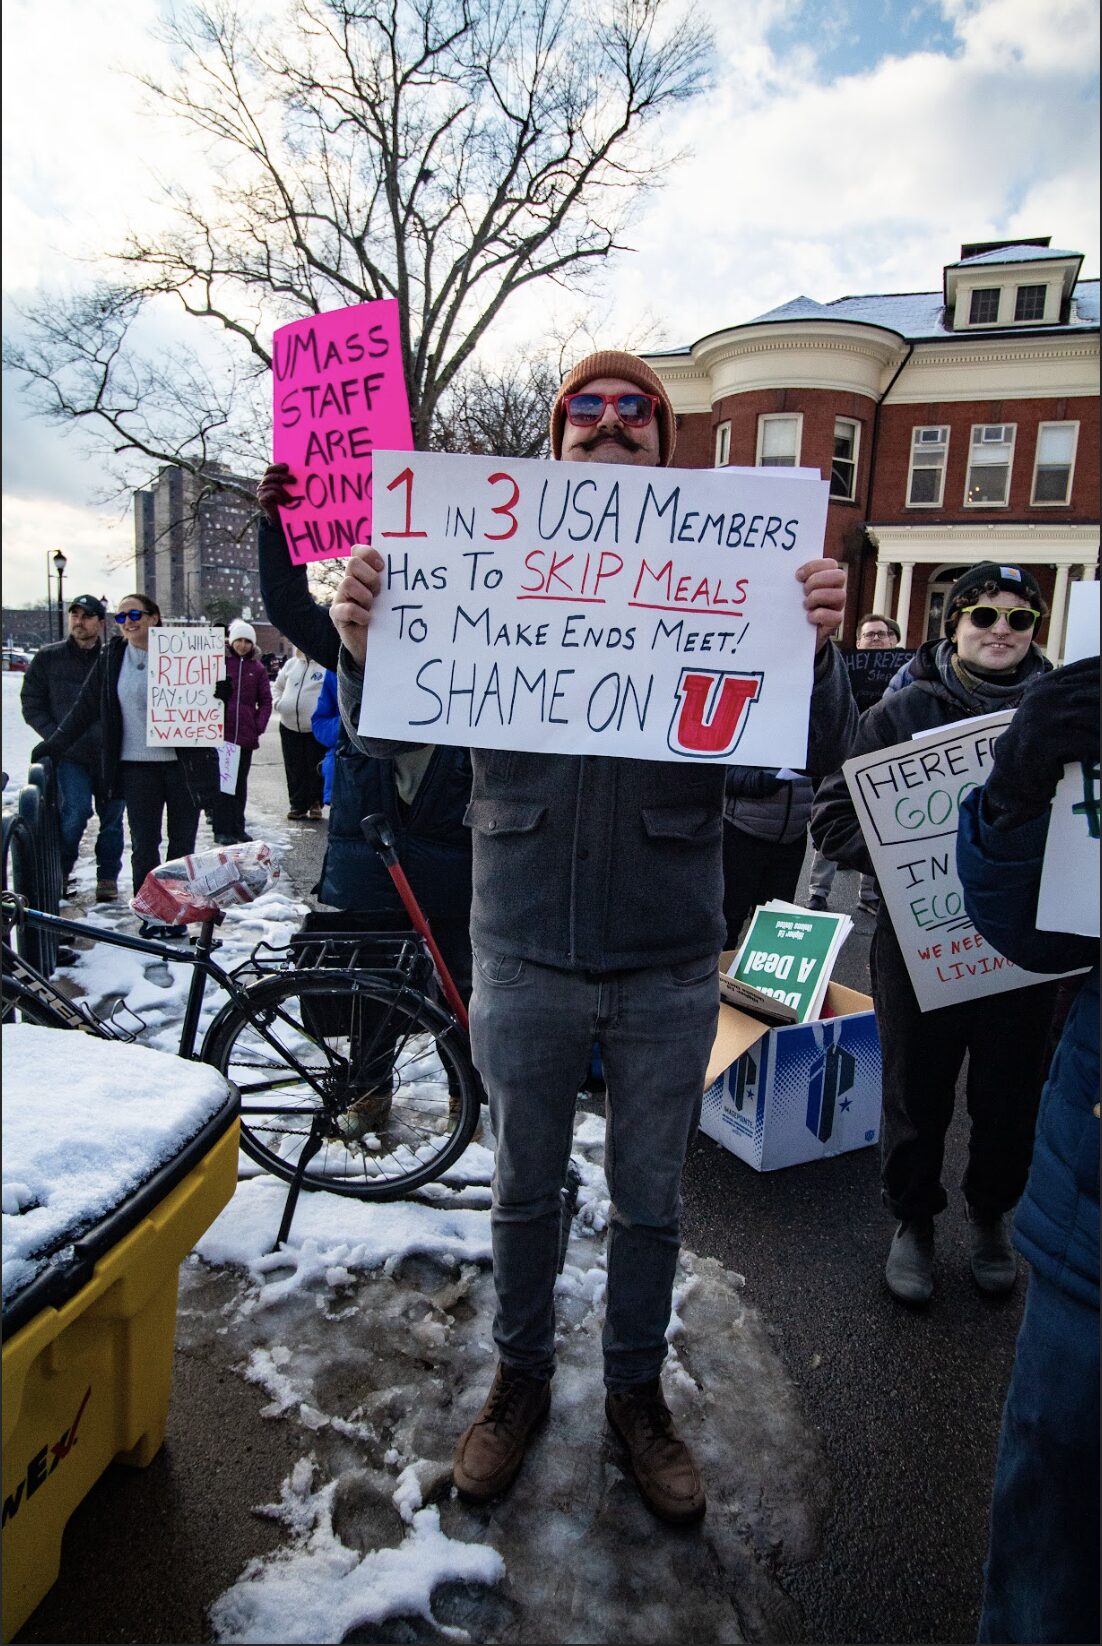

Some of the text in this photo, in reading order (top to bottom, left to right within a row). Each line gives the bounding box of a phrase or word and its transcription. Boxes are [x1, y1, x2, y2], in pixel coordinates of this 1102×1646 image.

[274, 325, 389, 382] UMASS
[281, 372, 384, 428] STAFF
[304, 427, 373, 467] ARE
[381, 467, 799, 551] 1 IN 3 USA MEMBERS
[387, 550, 749, 607] HAS TO SKIP MEALS
[158, 634, 183, 654] DO
[452, 605, 550, 647] MAKE
[561, 614, 636, 650] ENDS
[651, 618, 750, 654] MEET!
[158, 654, 224, 686] RIGHT
[152, 686, 208, 708] PAY US
[408, 658, 765, 758] SHAME ON U
[151, 708, 220, 723] LIVING
[154, 723, 223, 740] WAGES!
[865, 745, 969, 799] HERE
[897, 853, 949, 889] IN
[910, 892, 965, 928] ECO
[743, 950, 817, 984] A Deal
[918, 944, 942, 960] WE
